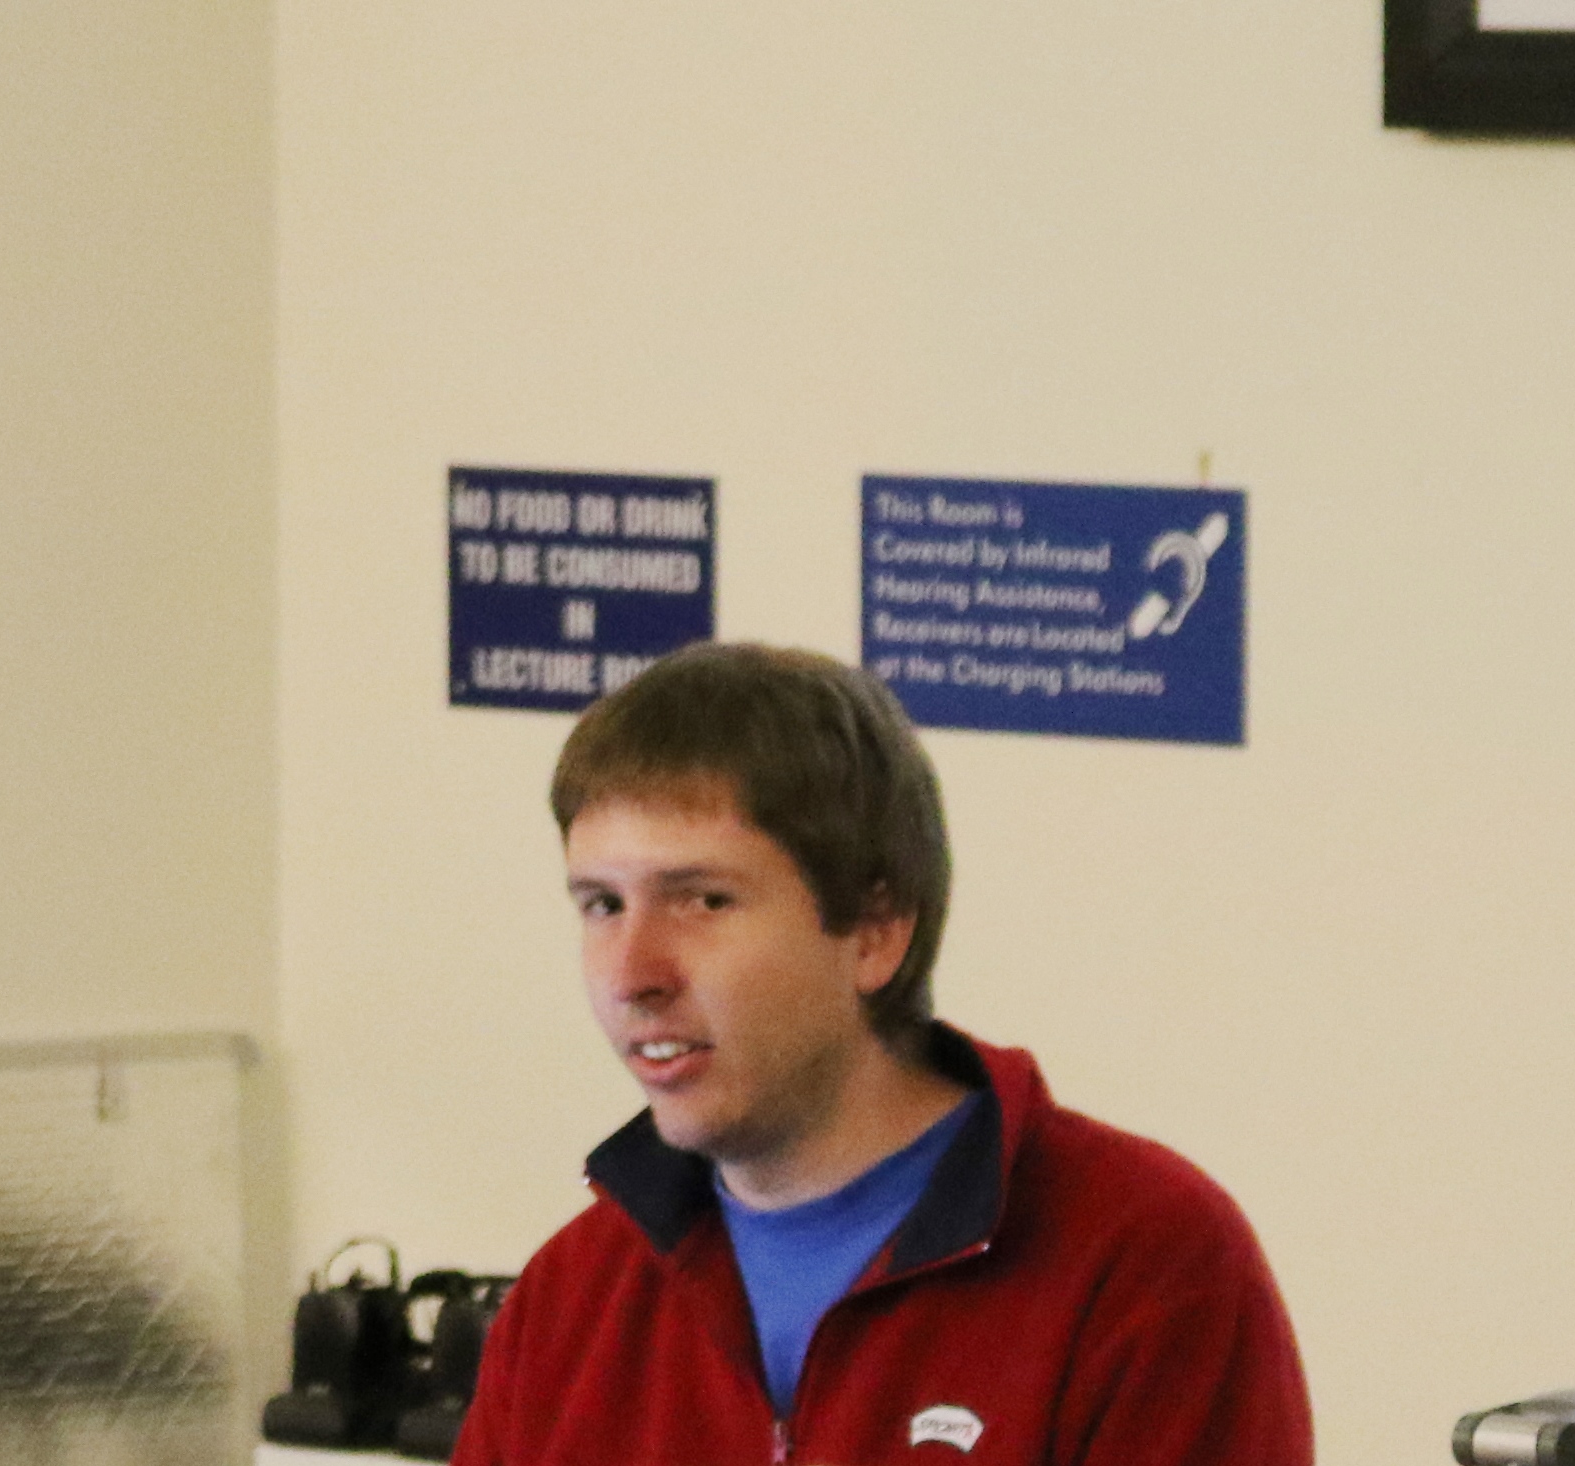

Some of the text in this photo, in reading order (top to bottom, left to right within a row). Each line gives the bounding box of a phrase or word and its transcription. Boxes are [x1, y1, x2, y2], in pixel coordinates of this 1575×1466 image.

[452, 480, 709, 541] NO FOOD OR DRINK
[875, 492, 1024, 528] This Room is
[459, 542, 701, 593] TO BE CONSUMED
[874, 534, 1111, 573] Covered by Infrared
[874, 574, 1106, 615] Hearing Assistance,
[561, 600, 596, 640] IN
[874, 612, 1126, 653] Receivers are Located
[472, 648, 596, 694] LECTURE
[874, 655, 1166, 697] at the Charging Stations
